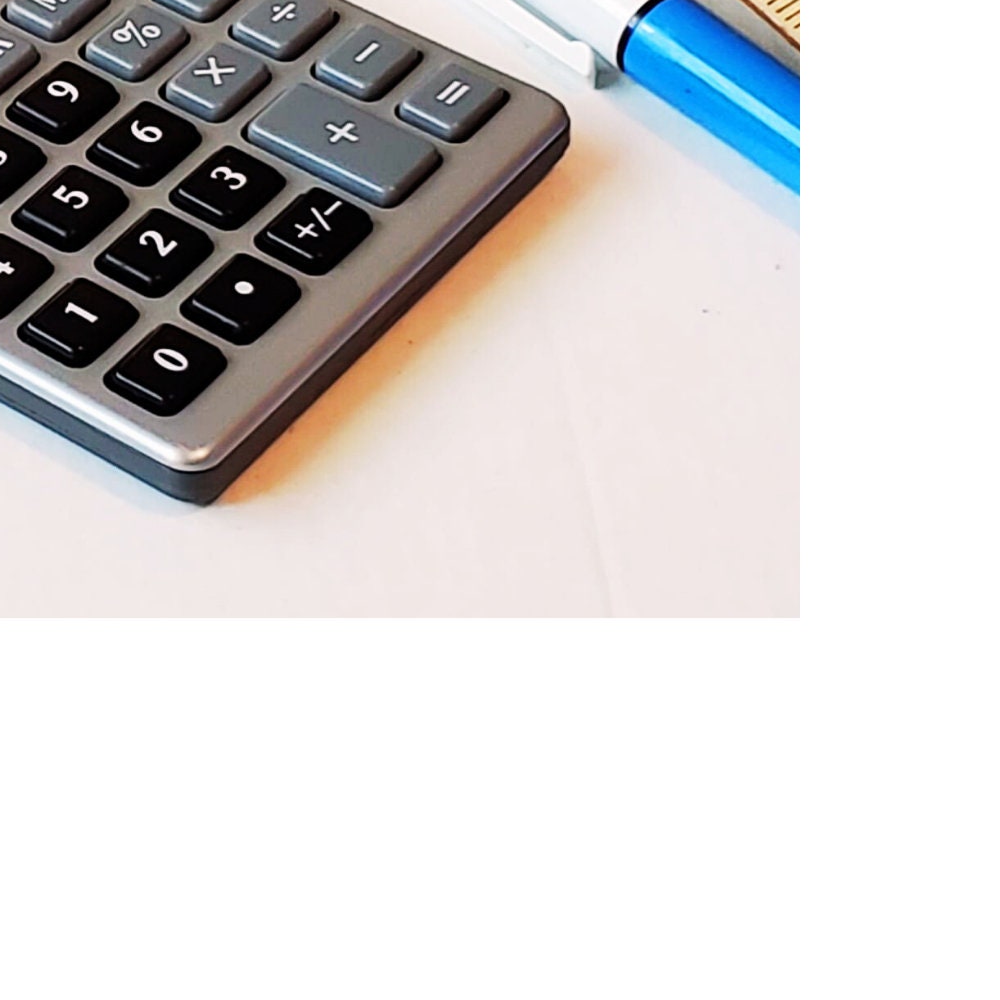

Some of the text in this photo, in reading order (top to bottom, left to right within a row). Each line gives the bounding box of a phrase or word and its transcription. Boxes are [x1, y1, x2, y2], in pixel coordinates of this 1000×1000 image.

[112, 19, 161, 47] %
[47, 80, 79, 103] 9
[130, 120, 163, 143] 6
[325, 121, 359, 144] +
[210, 166, 247, 190] 3
[52, 185, 89, 210] 5
[140, 230, 178, 257] 2
[65, 302, 99, 324] 1
[153, 349, 188, 372] 0
